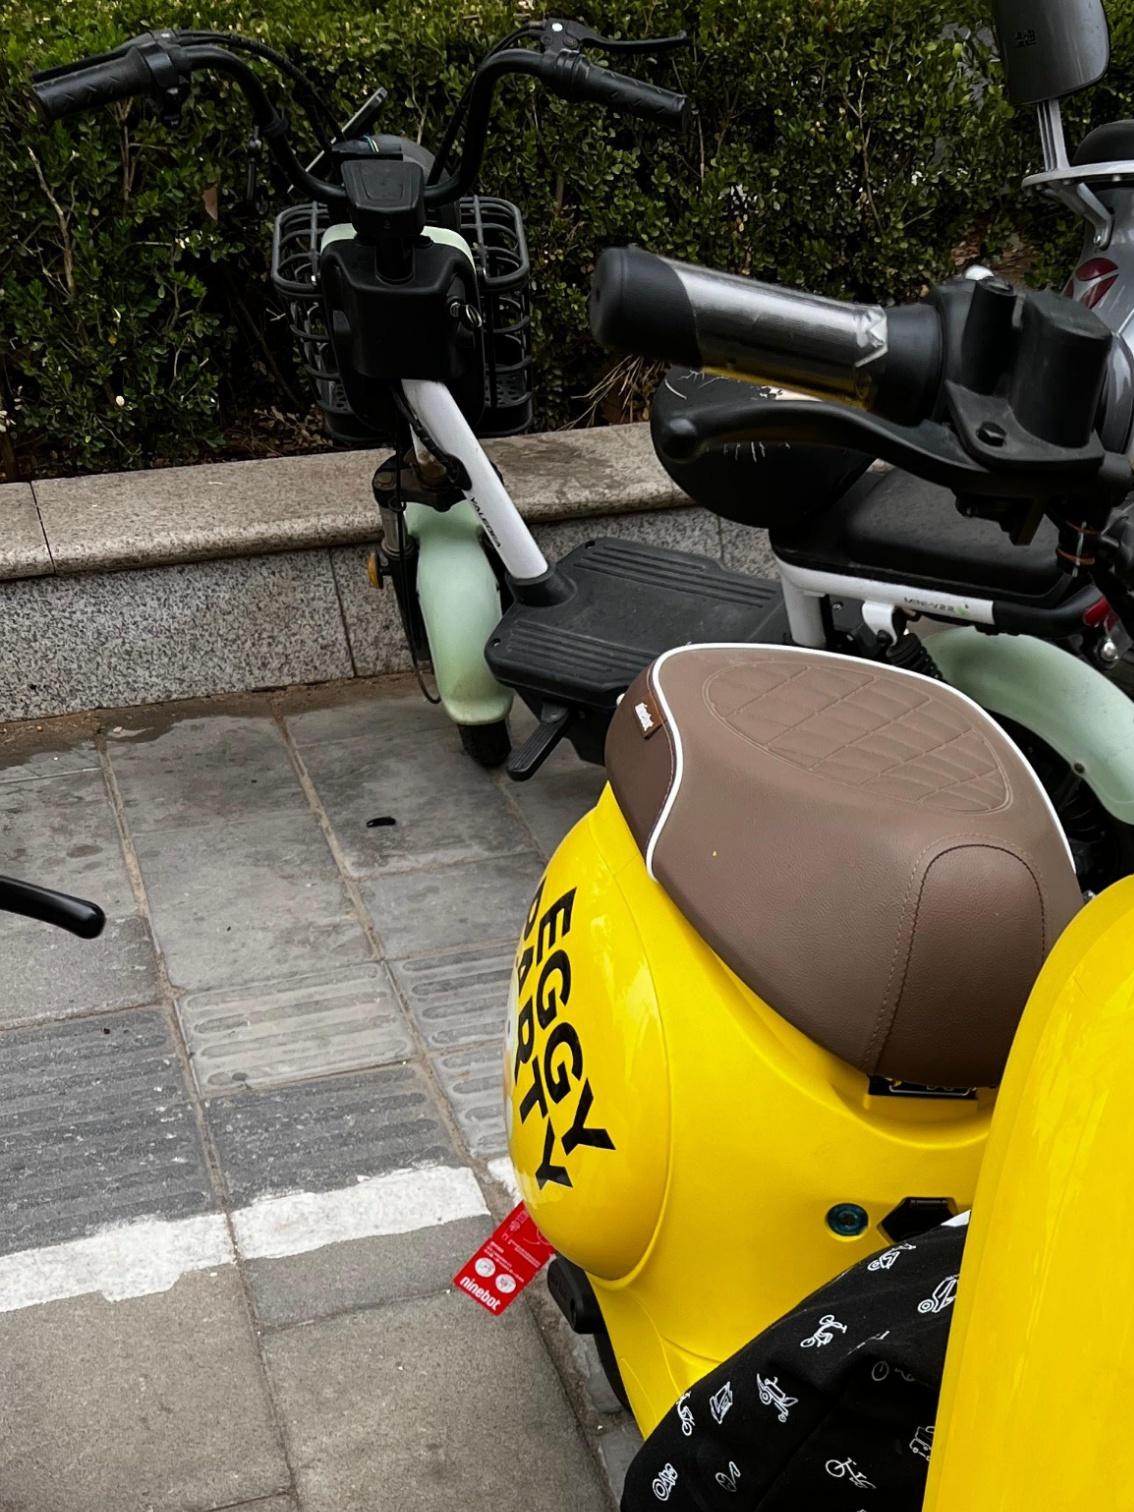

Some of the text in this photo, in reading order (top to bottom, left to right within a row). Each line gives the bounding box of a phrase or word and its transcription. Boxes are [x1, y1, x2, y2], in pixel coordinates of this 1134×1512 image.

[514, 876, 574, 1190] PARTY
[536, 886, 617, 1151] EGGY
[460, 1276, 501, 1311] ninebot
